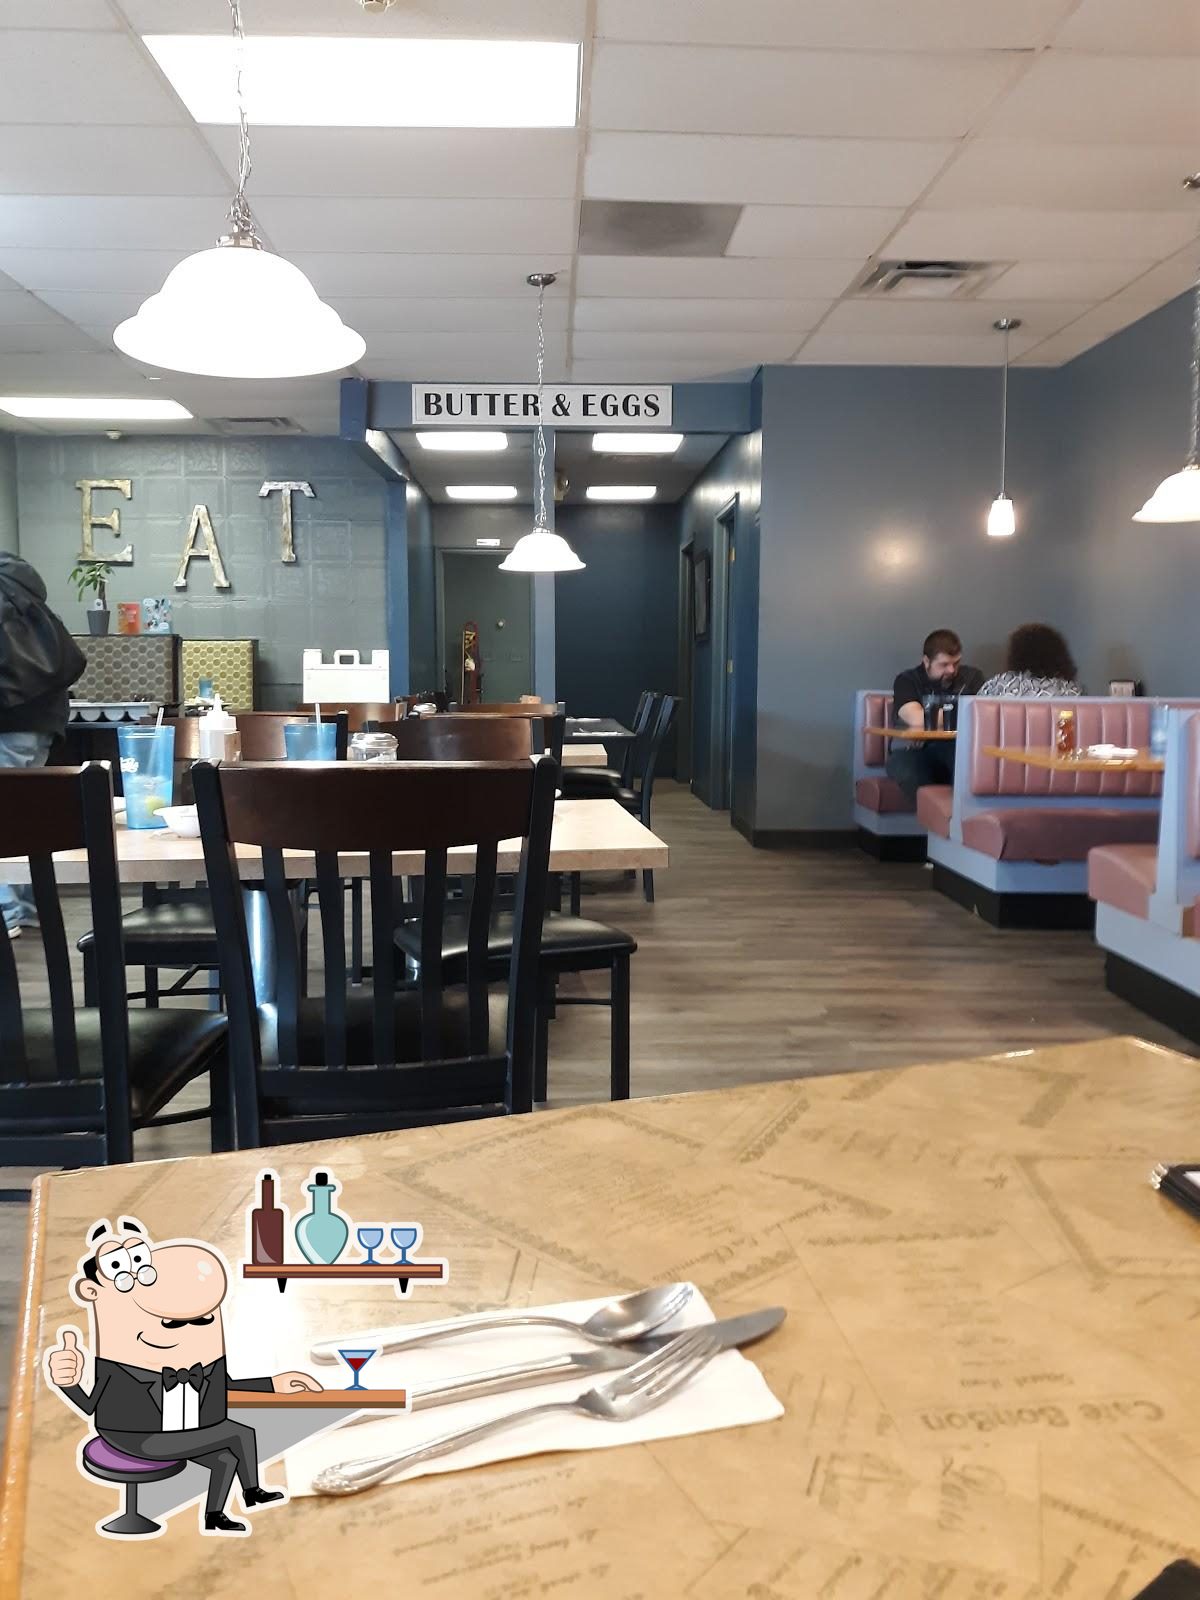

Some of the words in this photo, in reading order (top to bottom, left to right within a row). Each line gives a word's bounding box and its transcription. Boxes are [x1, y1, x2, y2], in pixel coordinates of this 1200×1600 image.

[424, 393, 540, 416] BUTTER
[552, 393, 571, 416] &
[582, 394, 660, 417] EGGS
